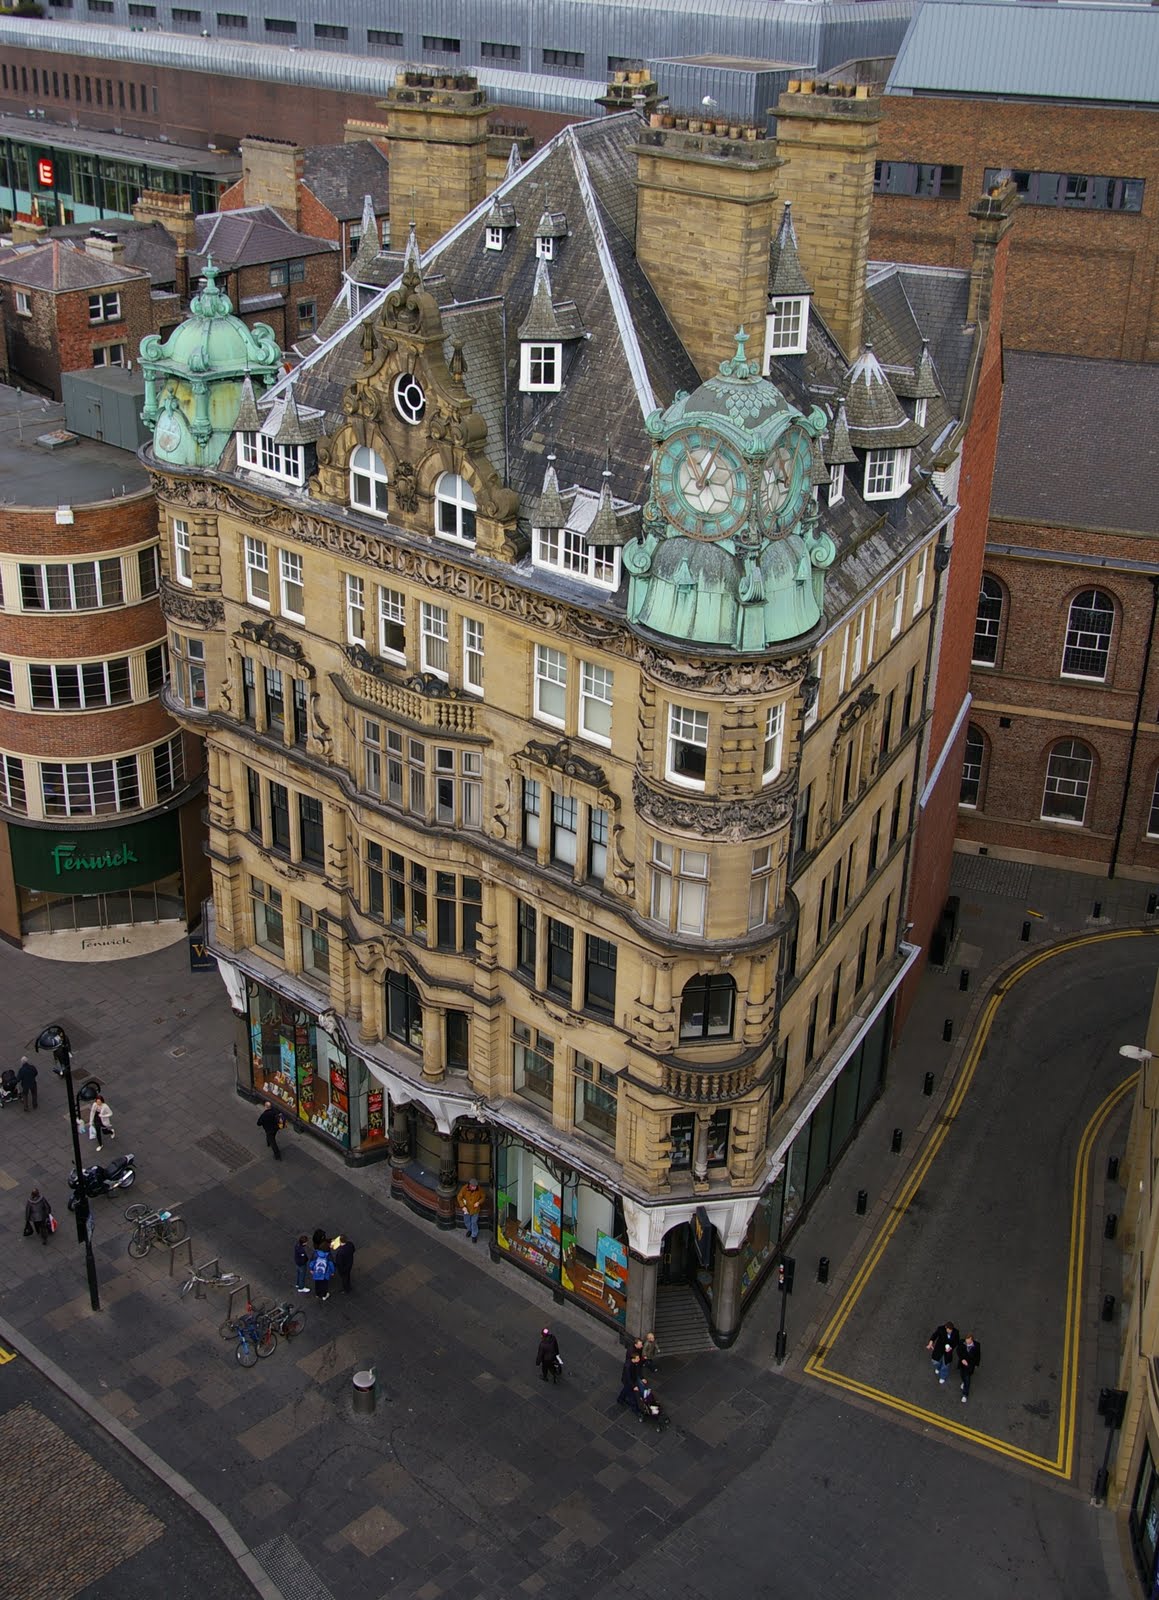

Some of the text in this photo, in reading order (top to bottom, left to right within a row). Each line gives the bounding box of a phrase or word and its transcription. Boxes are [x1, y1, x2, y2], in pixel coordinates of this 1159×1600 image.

[422, 558, 557, 628] CHAMBERS
[52, 843, 138, 875] Fenwick
[82, 937, 131, 950] Fenwick
